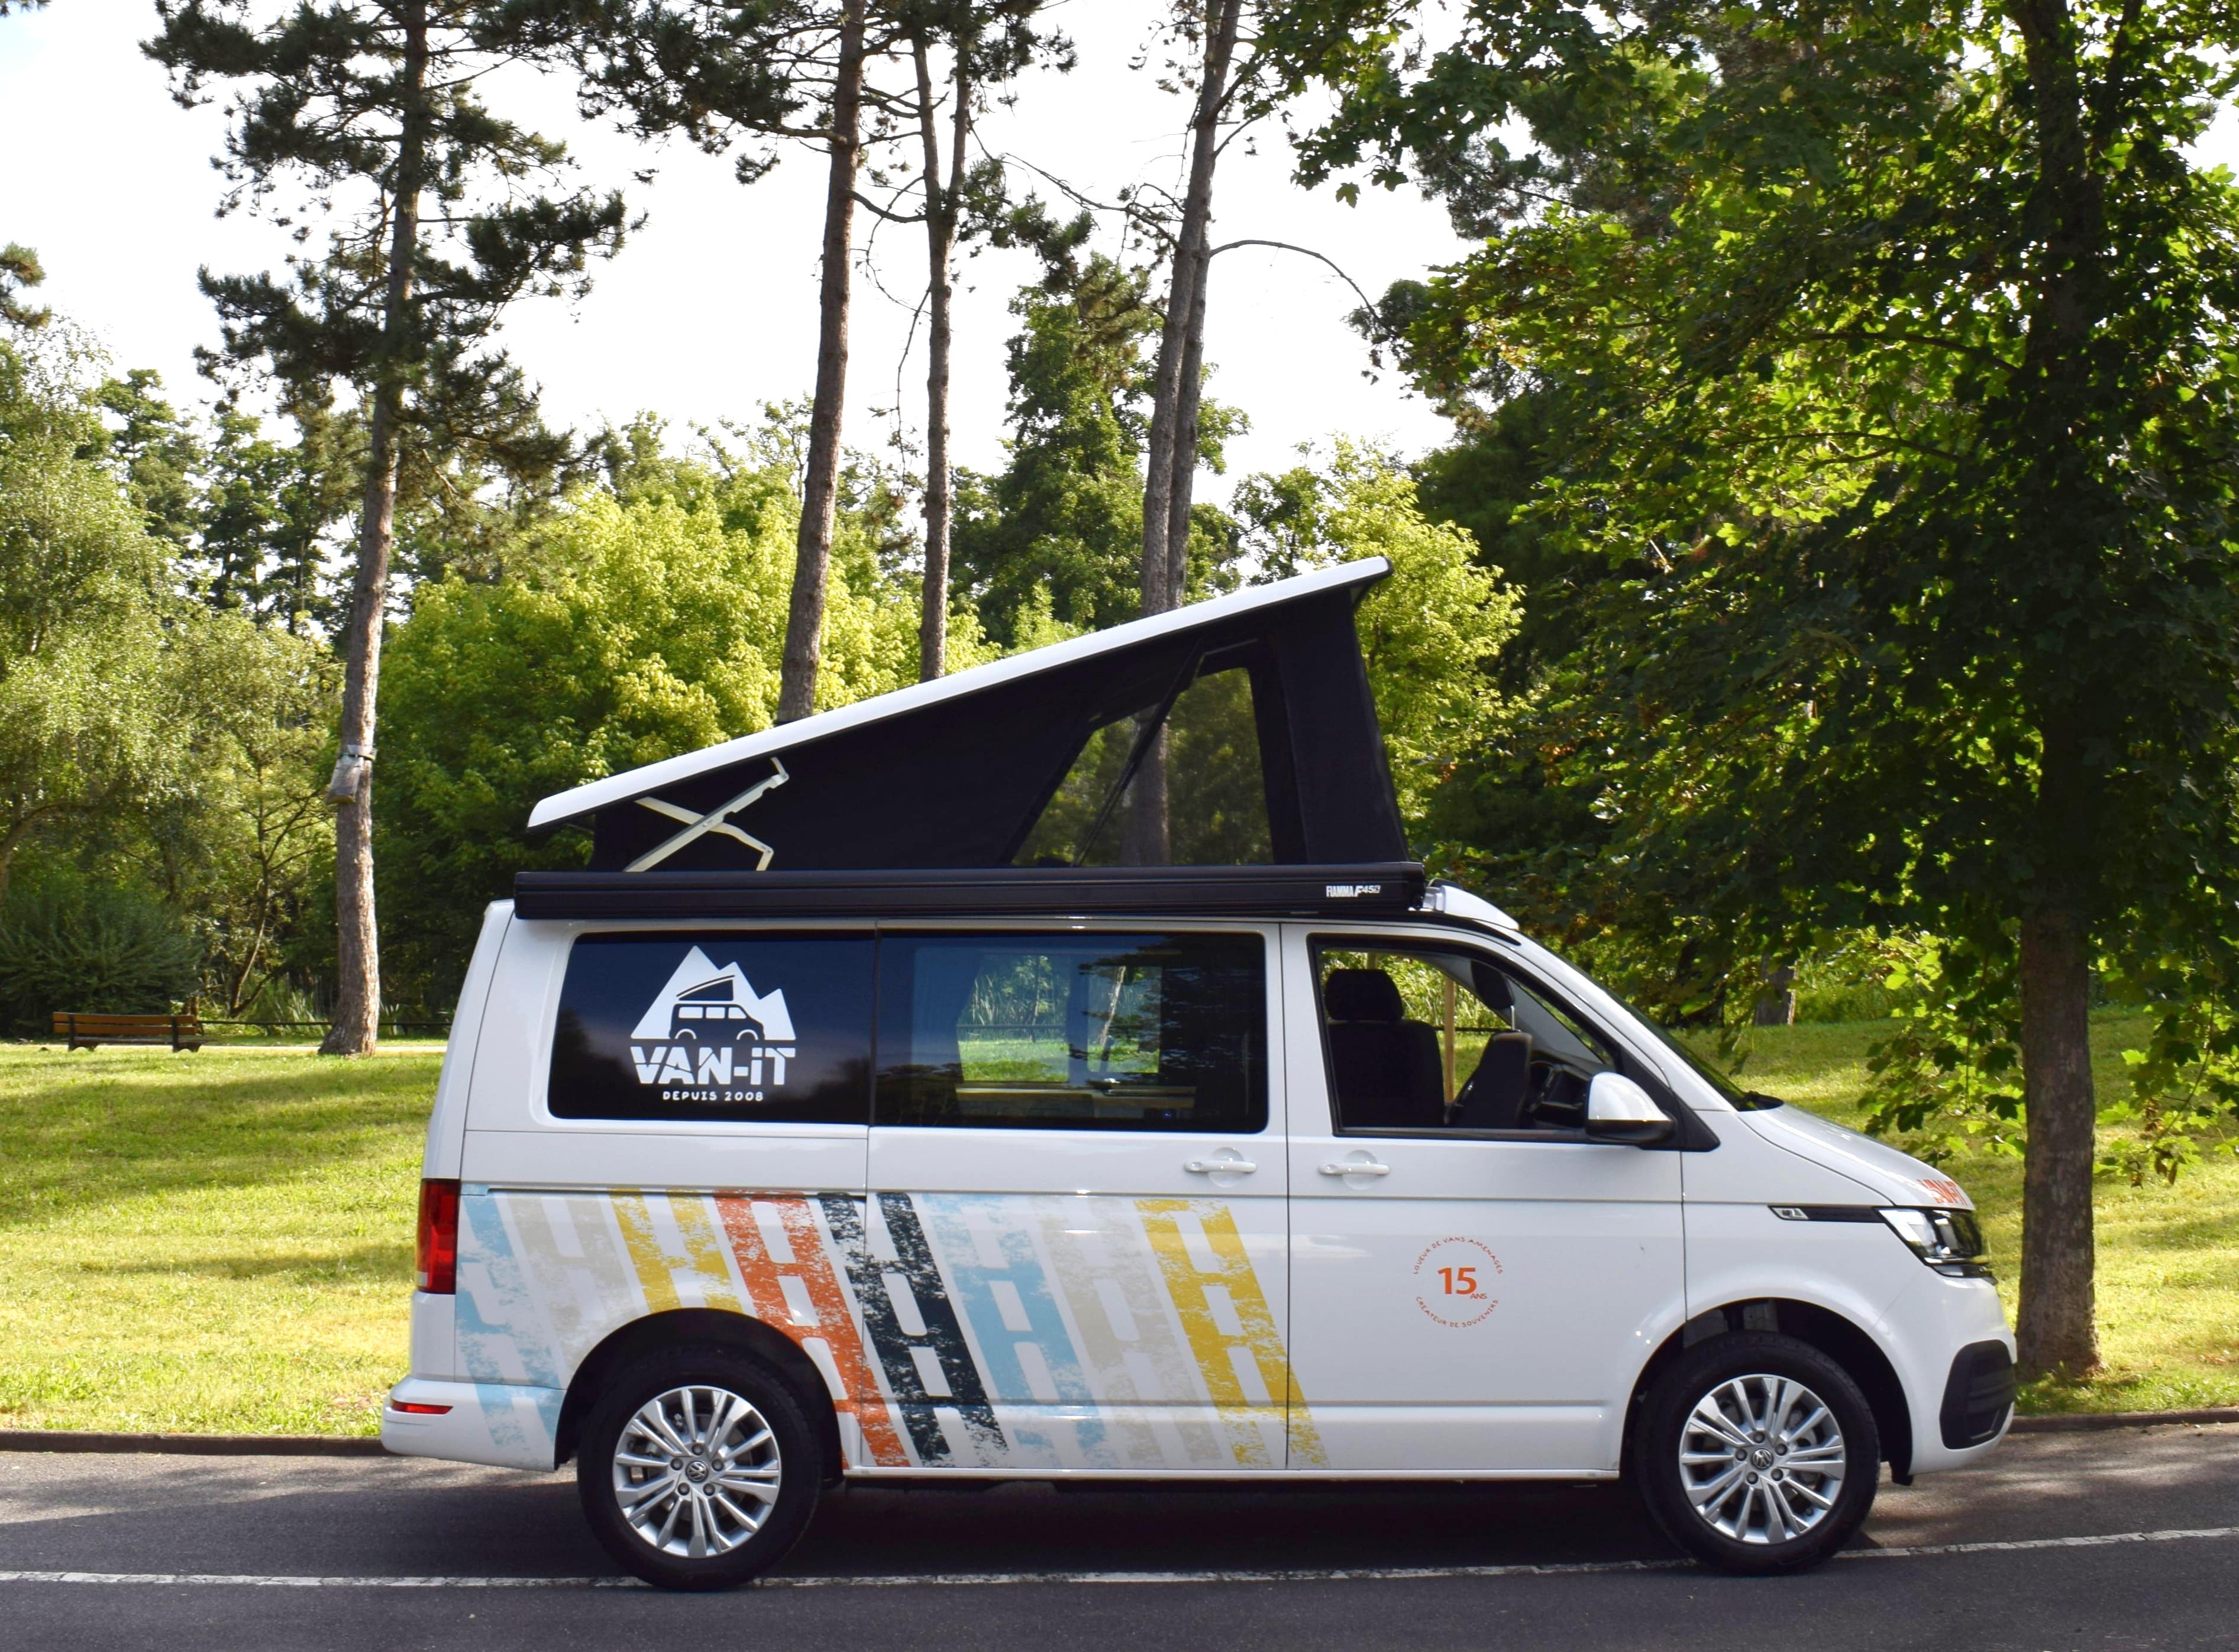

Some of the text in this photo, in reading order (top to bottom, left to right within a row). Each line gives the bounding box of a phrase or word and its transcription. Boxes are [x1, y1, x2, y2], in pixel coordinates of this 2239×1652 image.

[1326, 885, 1354, 897] FIAMMA
[663, 1091, 764, 1101] DEPUIS 2008
[1413, 1248, 1431, 1275] LOUEUR
[1437, 1267, 1477, 1295] 15
[1462, 1299, 1499, 1328] SOUVENIRS
